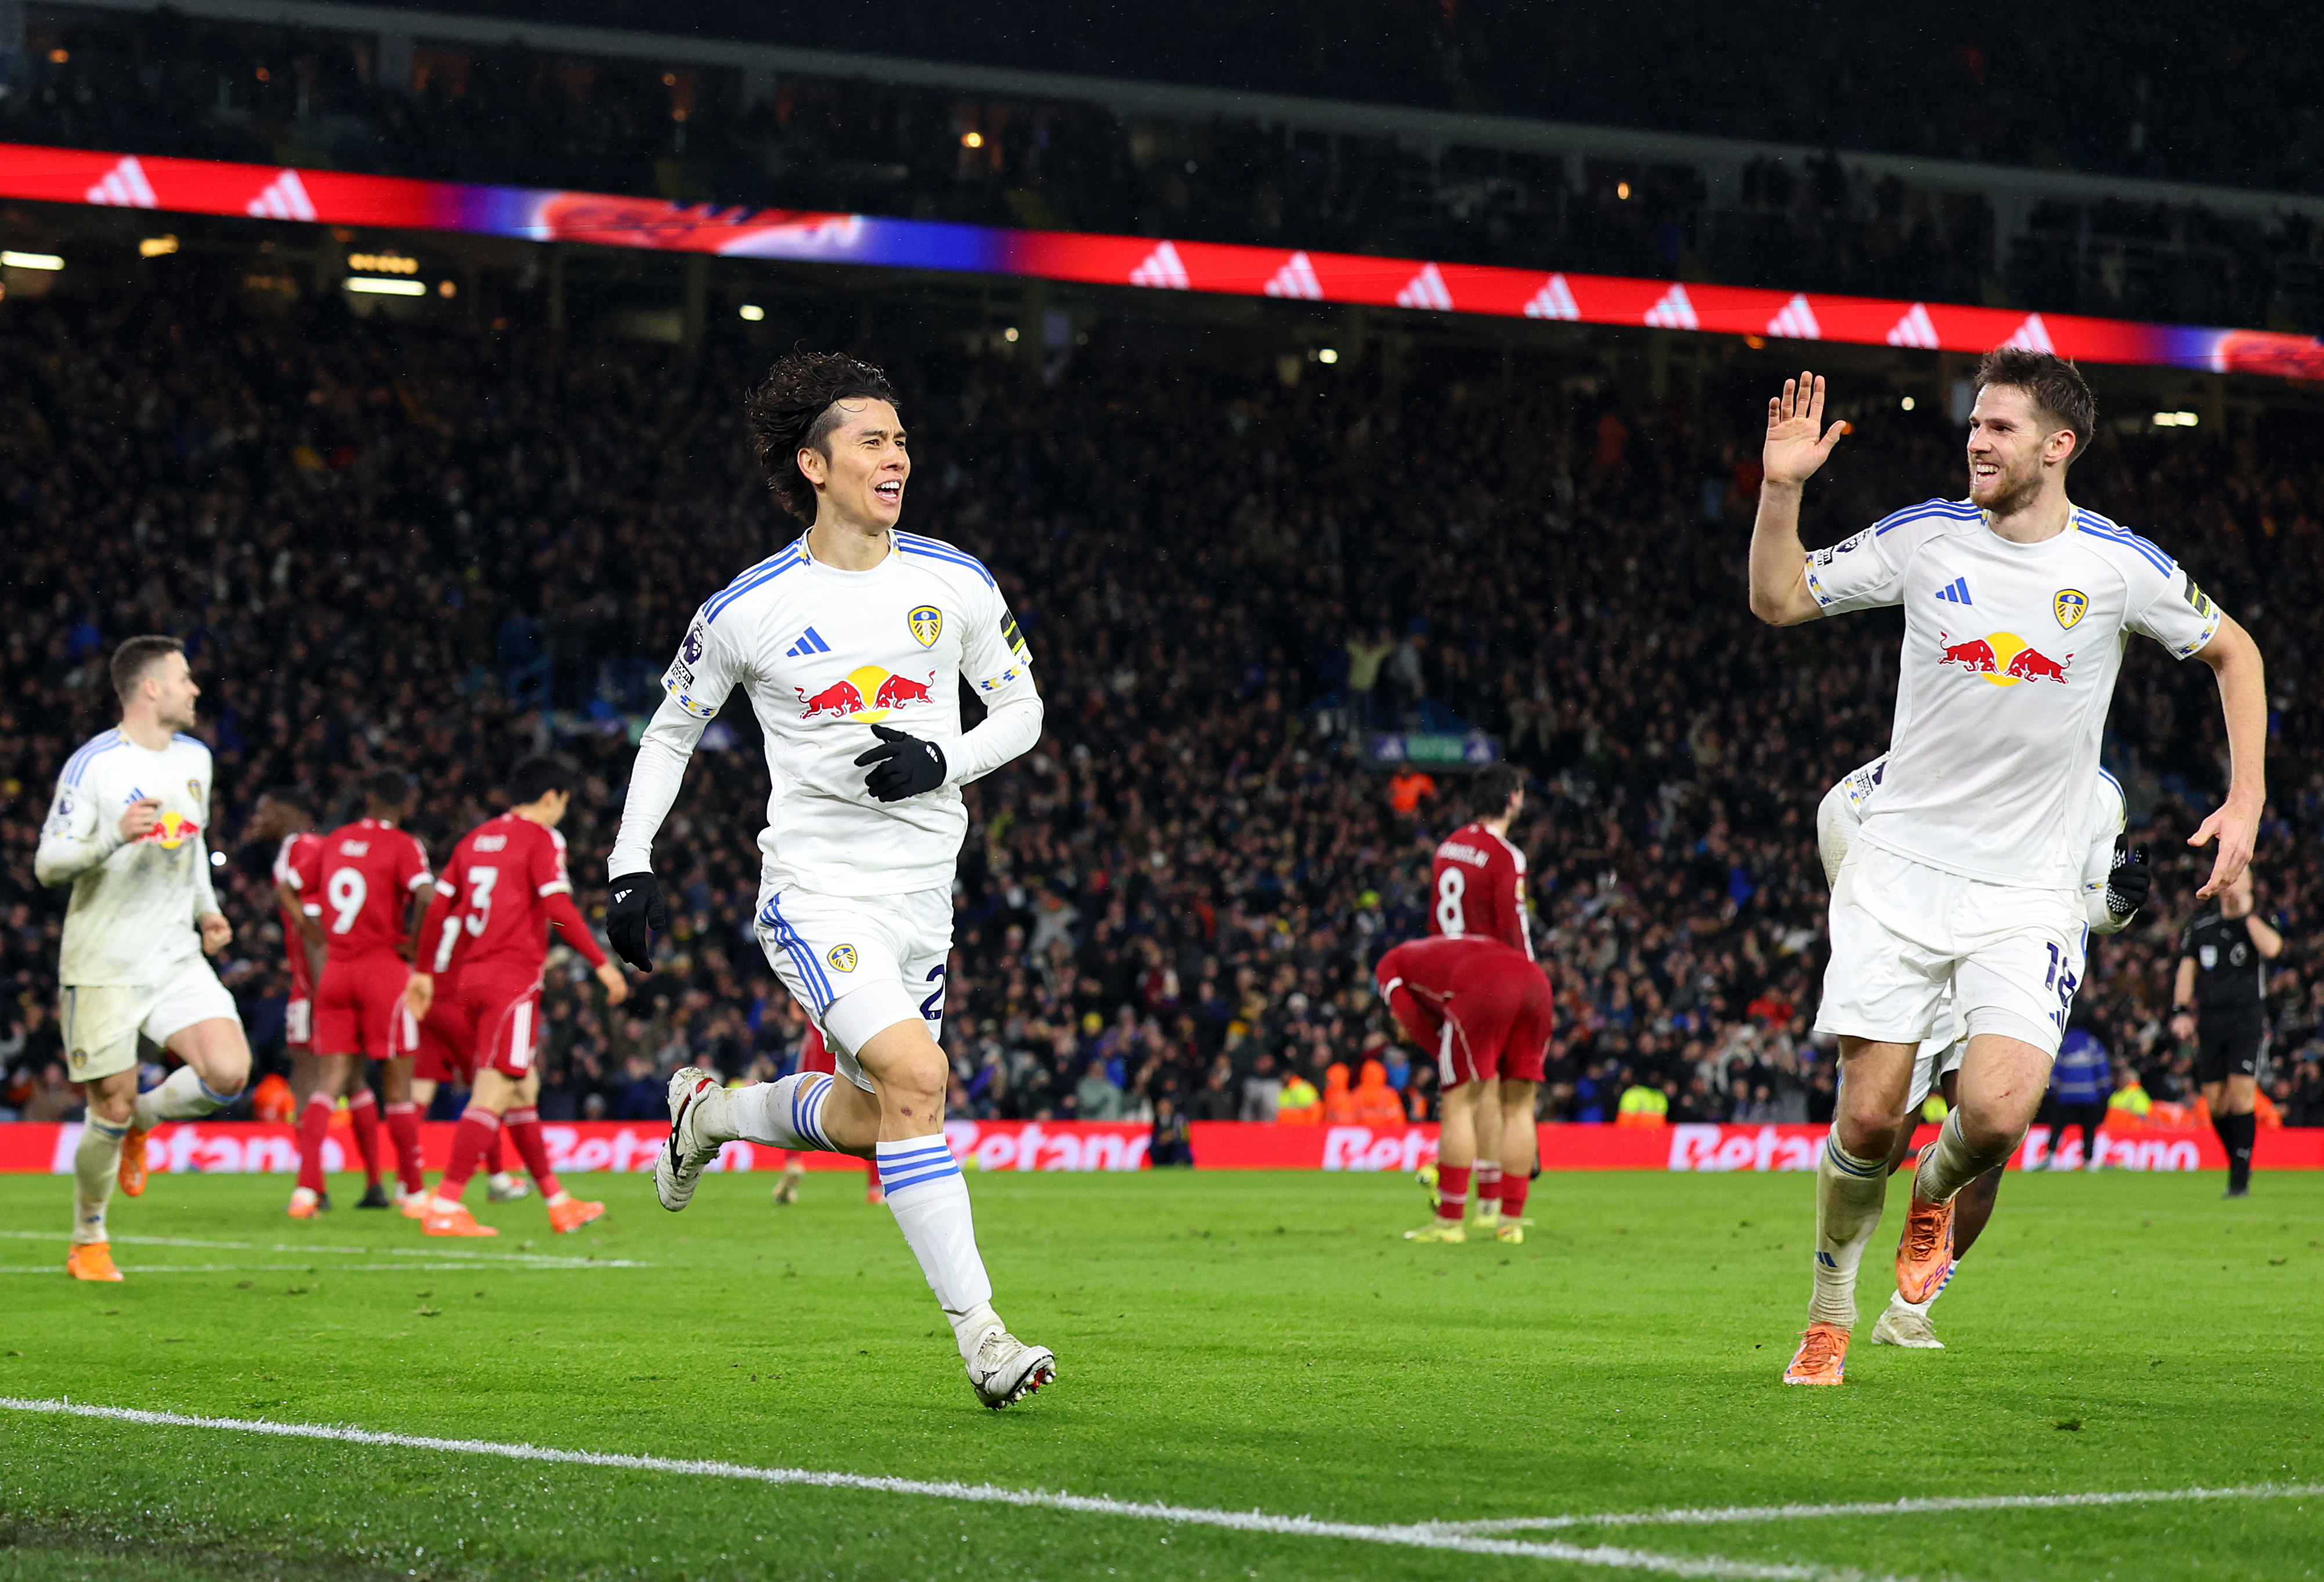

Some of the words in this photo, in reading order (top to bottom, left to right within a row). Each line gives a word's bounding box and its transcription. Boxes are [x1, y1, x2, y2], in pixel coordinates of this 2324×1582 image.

[328, 867, 367, 935] 9
[466, 866, 498, 937] 3
[1436, 866, 1466, 940] 8
[919, 963, 946, 1020] 2
[2045, 941, 2077, 1009] 18
